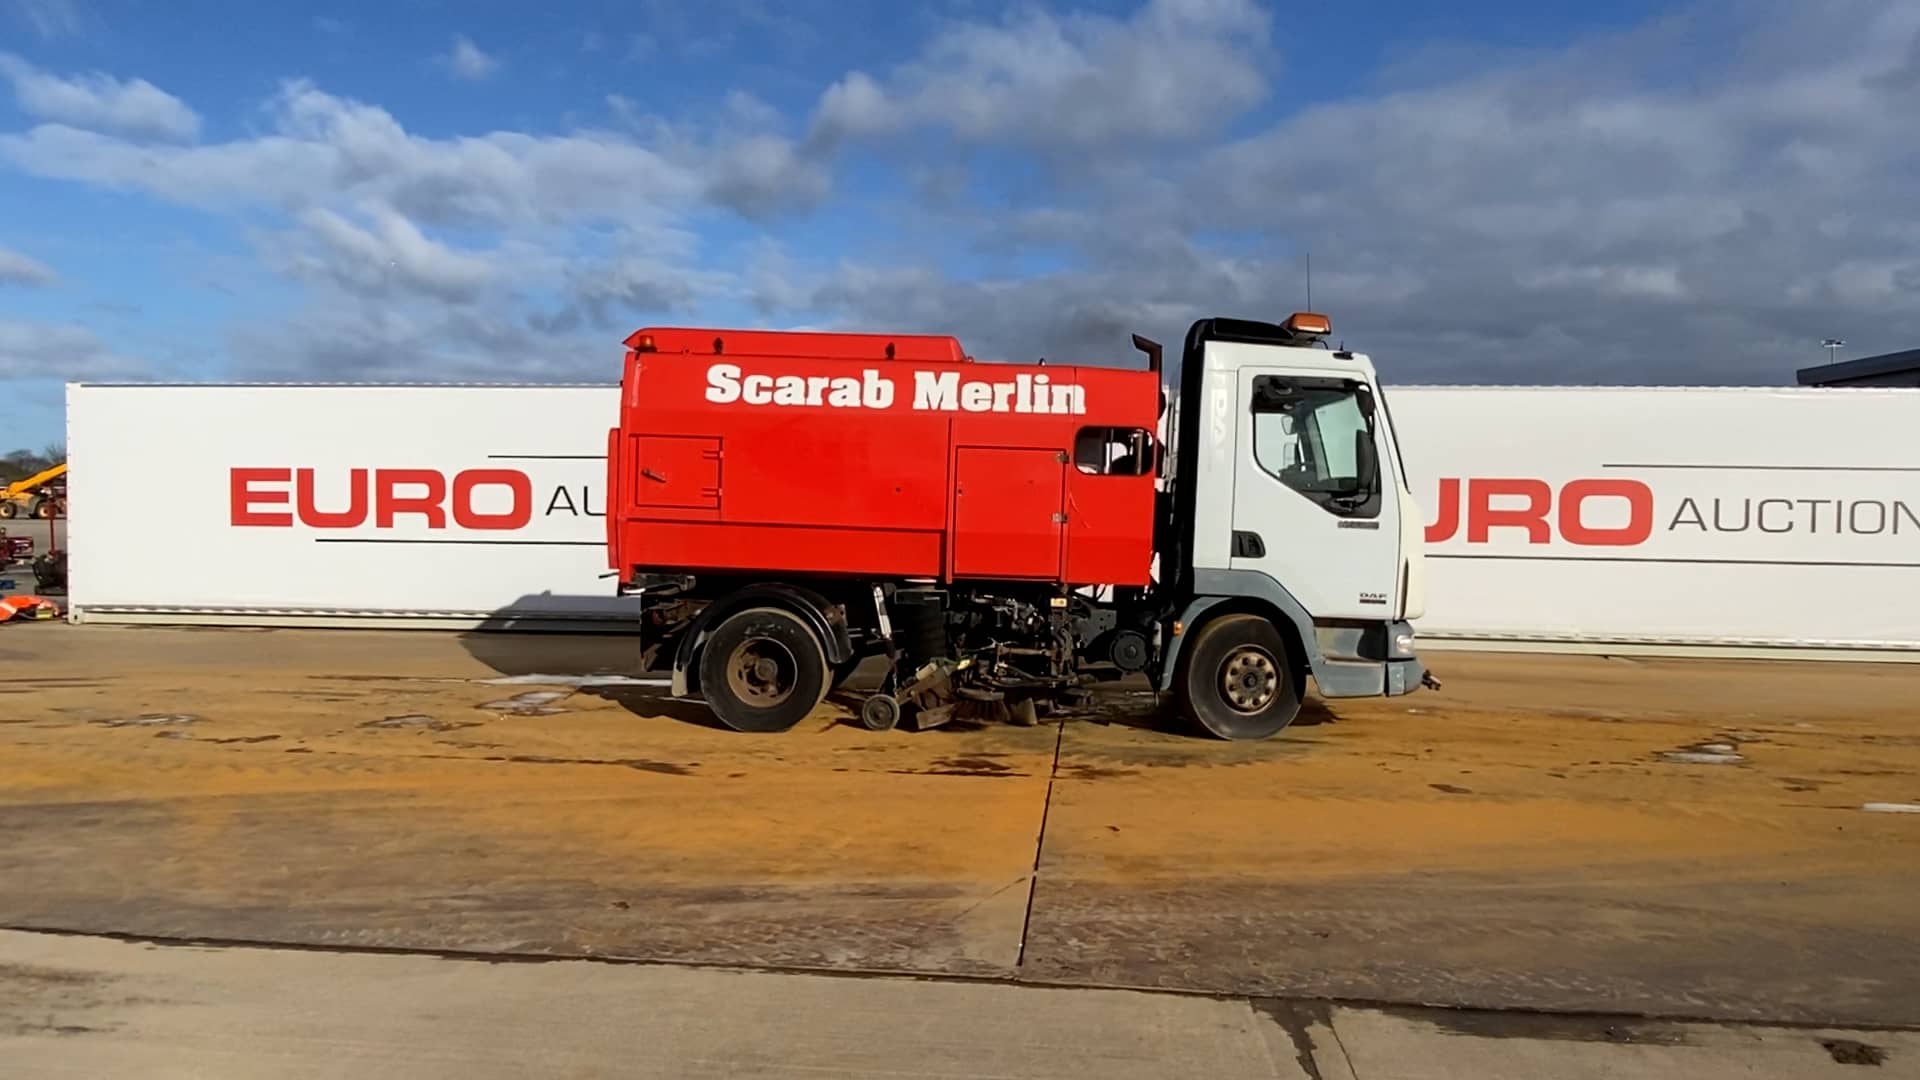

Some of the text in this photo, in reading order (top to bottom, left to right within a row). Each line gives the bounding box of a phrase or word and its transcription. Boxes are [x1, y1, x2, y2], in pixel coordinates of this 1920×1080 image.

[705, 363, 1087, 415] Scarab Merlin
[230, 467, 532, 530] EURO
